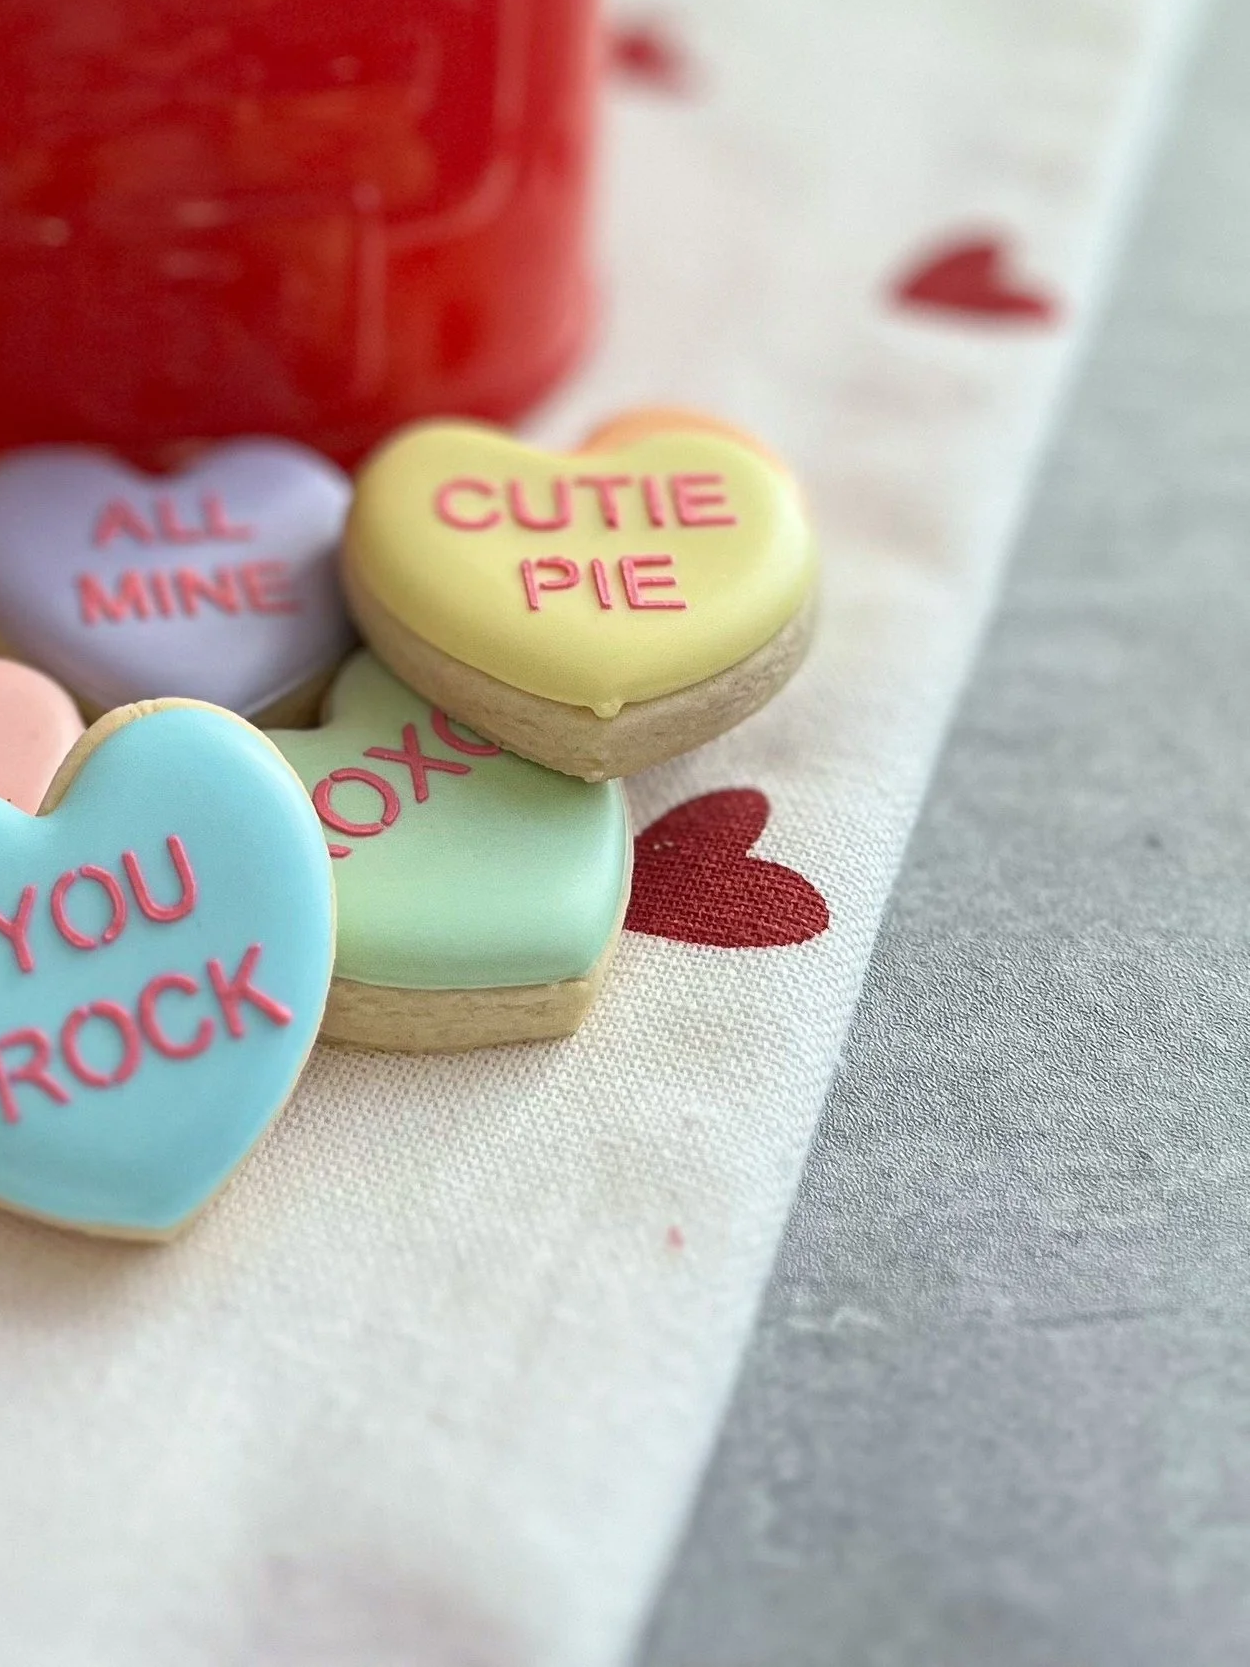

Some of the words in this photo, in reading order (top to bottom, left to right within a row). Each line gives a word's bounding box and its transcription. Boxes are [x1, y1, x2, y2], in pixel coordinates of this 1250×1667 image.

[92, 491, 257, 547] ALL
[433, 474, 737, 533] CUTIE
[75, 558, 301, 626] MINE
[520, 555, 688, 611] PIE
[313, 705, 503, 859] OX
